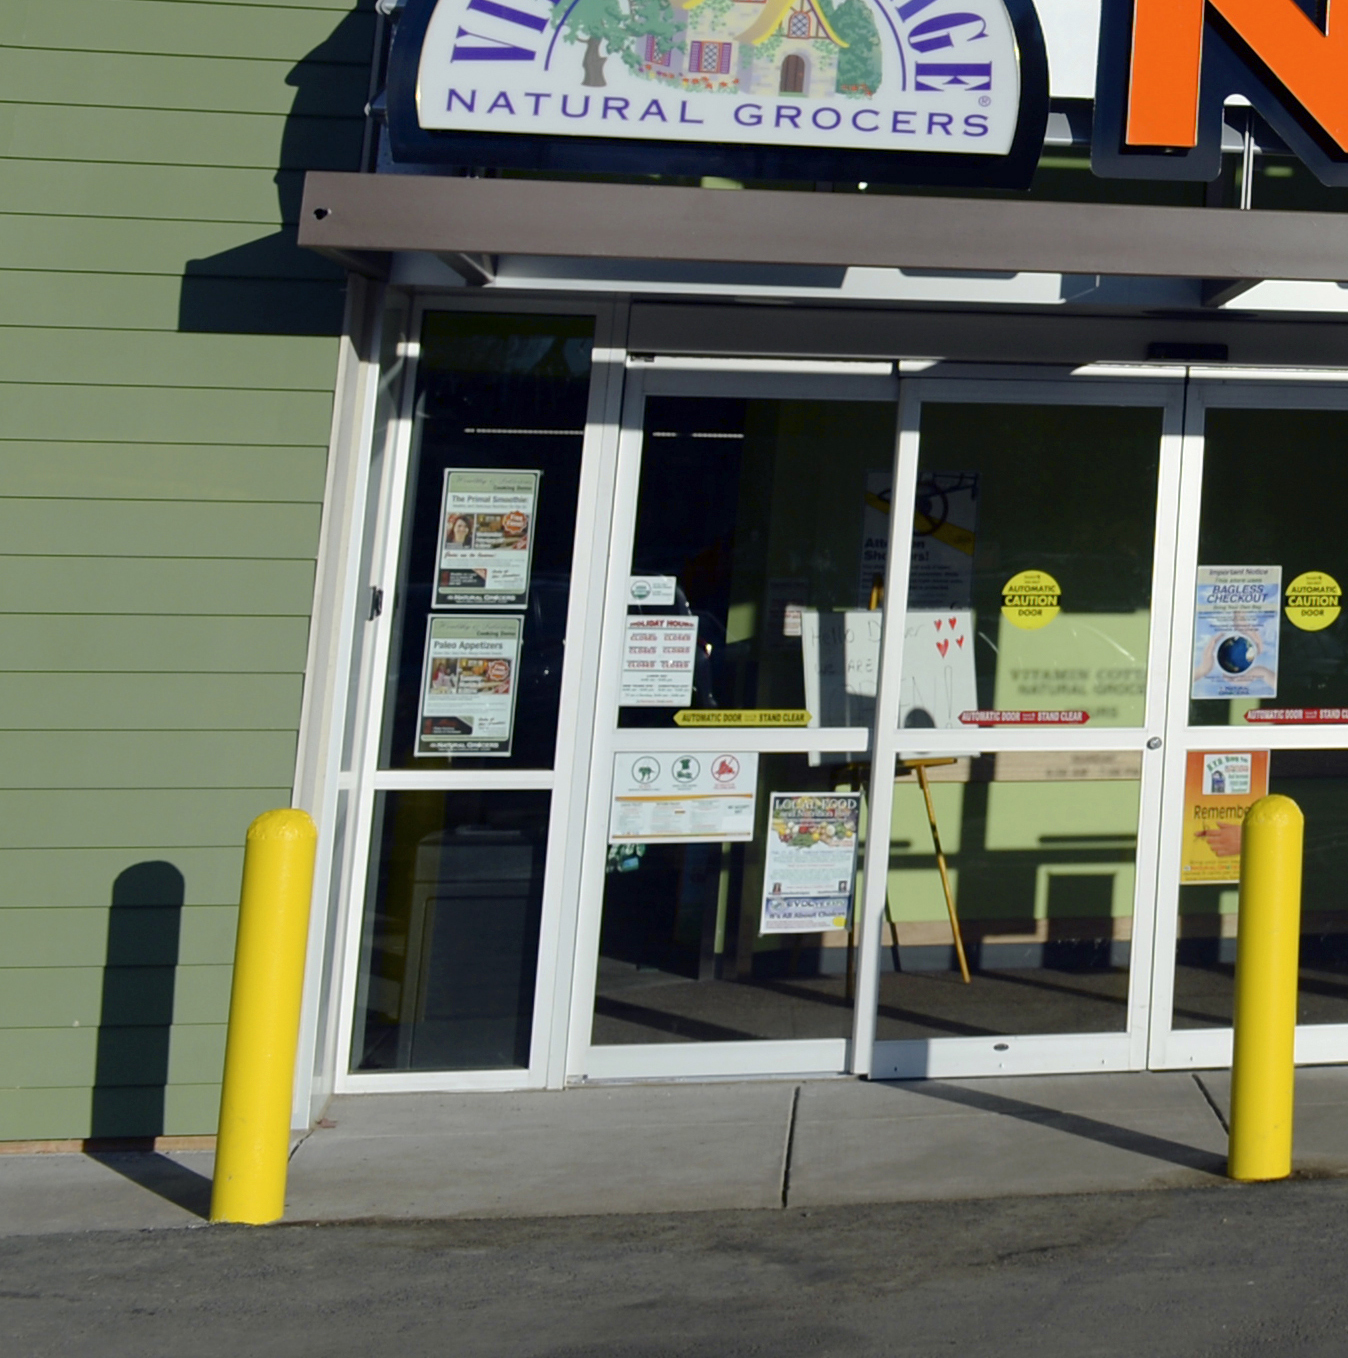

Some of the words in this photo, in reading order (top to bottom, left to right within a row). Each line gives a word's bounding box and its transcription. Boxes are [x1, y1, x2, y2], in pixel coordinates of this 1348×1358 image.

[446, 87, 705, 125] NATURAL
[734, 103, 990, 138] GROCERS
[1008, 585, 1056, 593] AUTOMATIC
[1212, 584, 1264, 594] BAGLESS
[1291, 586, 1337, 594] AUTOMATIC
[1004, 595, 1058, 606] CAUTION
[1207, 593, 1268, 603] CHECKOUT
[1288, 596, 1339, 606] CAUTION
[1018, 608, 1043, 616] DOOR
[1301, 609, 1325, 617] DOOR
[434, 641, 457, 649] Paleo
[459, 641, 503, 651] Appetizers
[682, 714, 722, 722] AUTOMATIC
[723, 714, 742, 722] DOOR
[758, 713, 782, 721] STAND
[783, 713, 805, 721] CLEAR
[961, 711, 1000, 721] AUTOMATIC
[1001, 711, 1021, 721] DOOR
[1037, 711, 1059, 721] STAND
[1060, 711, 1083, 721] CLEAR
[1247, 709, 1284, 720] AUTOMATIC
[1285, 709, 1303, 720] DOOR
[1319, 709, 1340, 720] STAND
[821, 798, 857, 810] FOOD
[1193, 804, 1251, 820] Remembe
